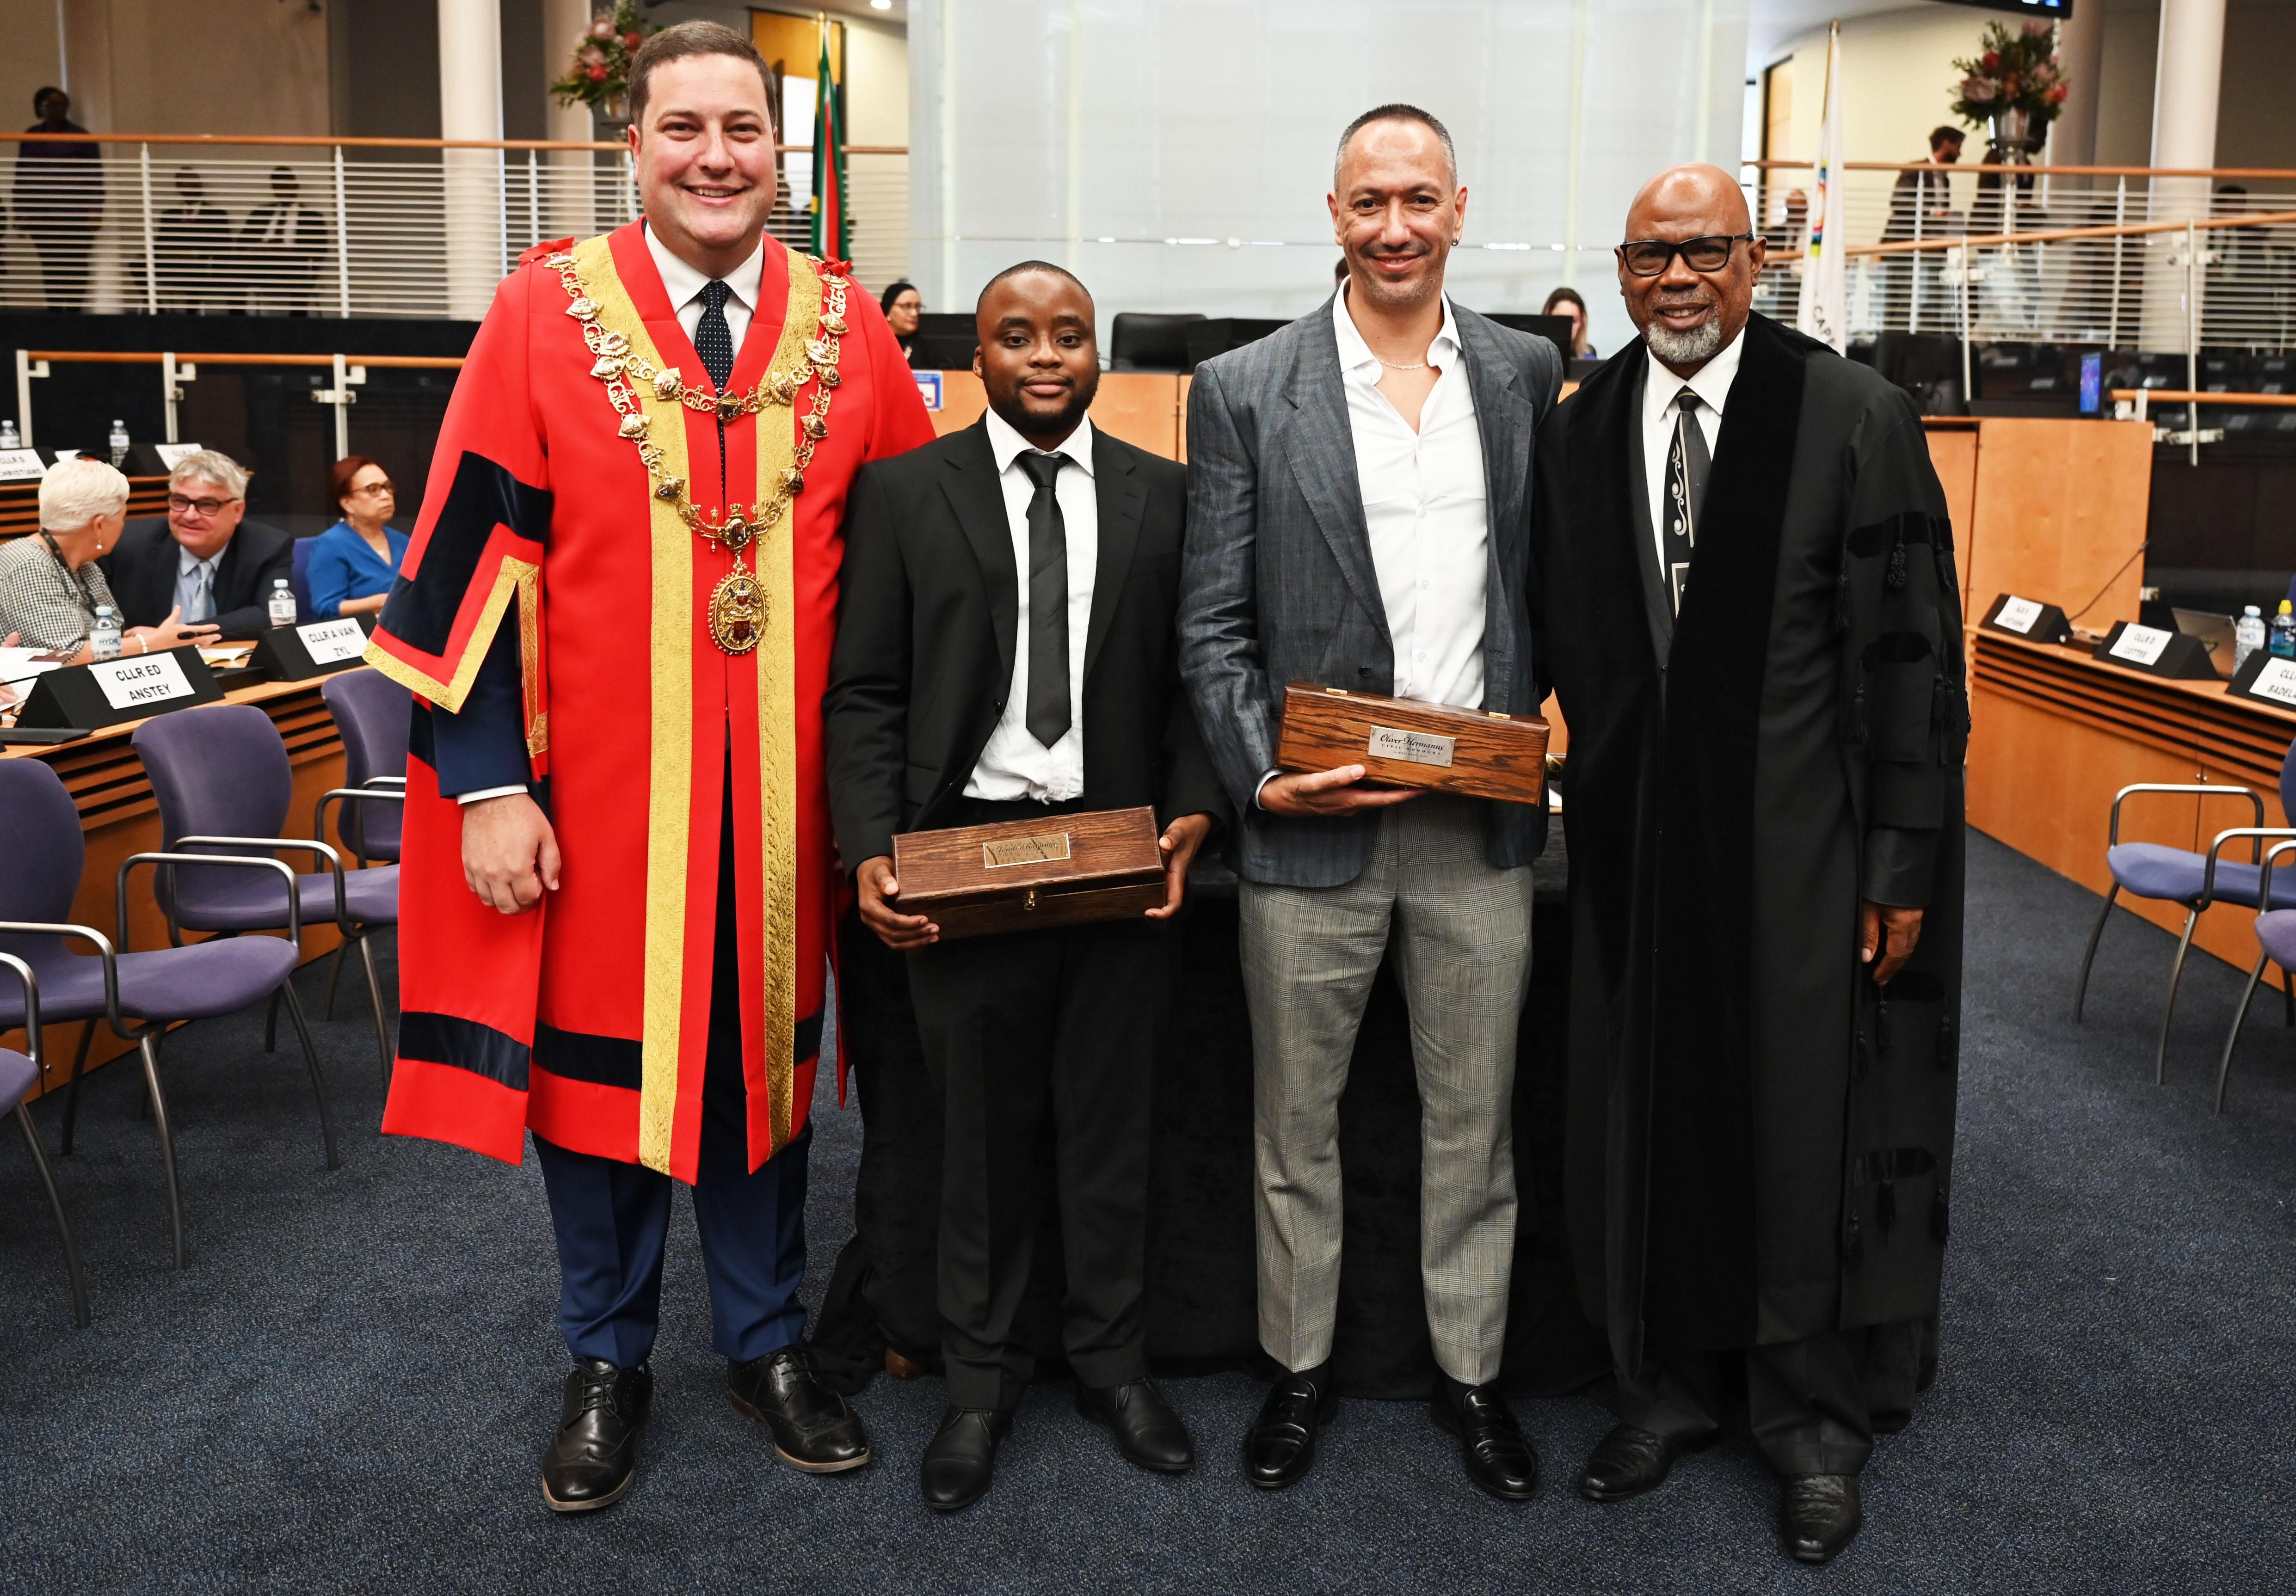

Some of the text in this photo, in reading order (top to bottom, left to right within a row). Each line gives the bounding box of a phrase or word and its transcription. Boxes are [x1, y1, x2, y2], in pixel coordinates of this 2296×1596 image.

[309, 631, 330, 643] CLLR
[339, 626, 355, 636] VAN
[333, 646, 351, 656] ZYL
[116, 665, 161, 681] CLLR ED
[2280, 669, 2296, 680] CLL
[129, 684, 171, 700] ANSTEY
[1380, 734, 1445, 751] Oliver Hermanus
